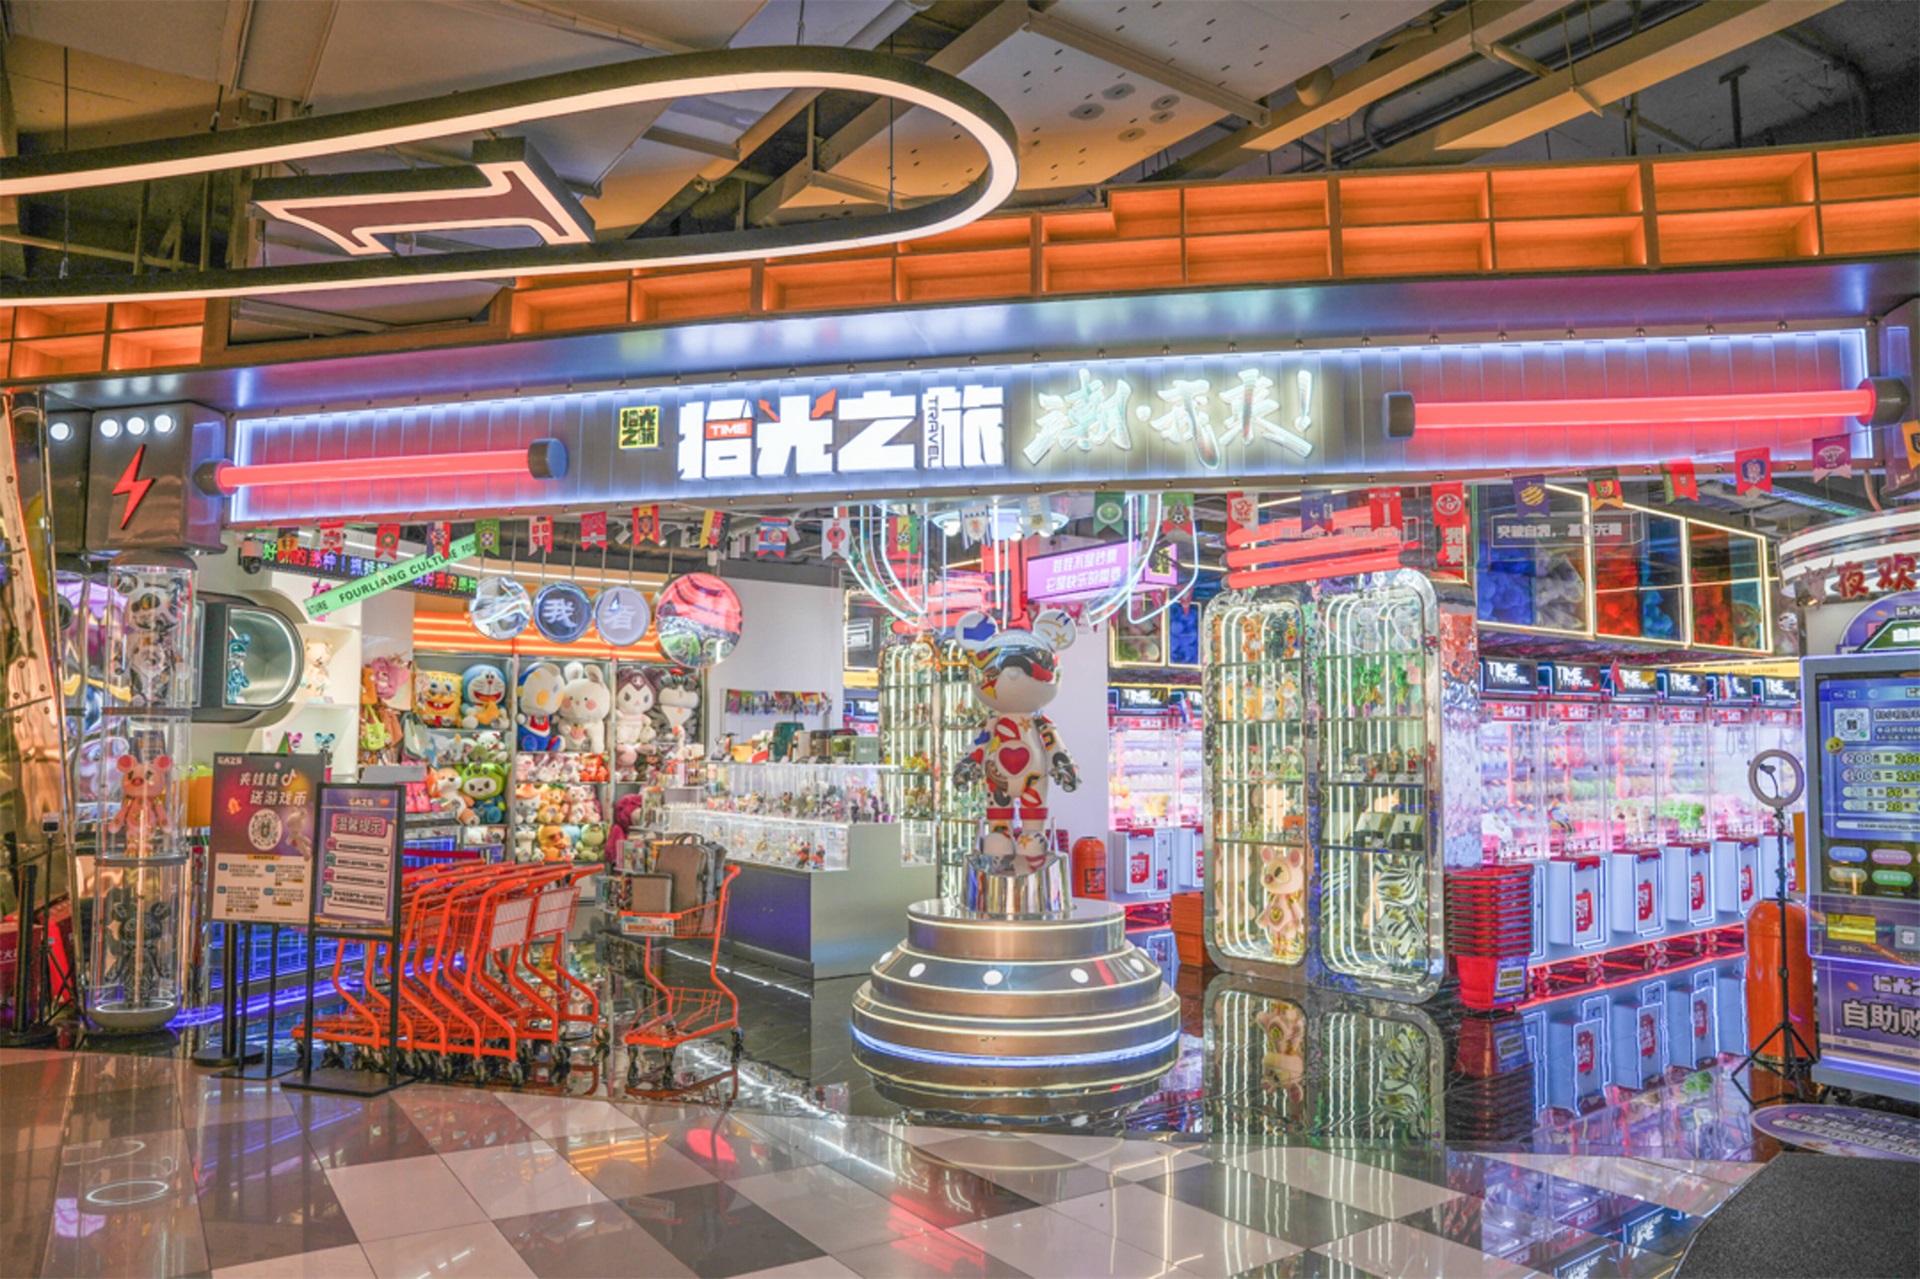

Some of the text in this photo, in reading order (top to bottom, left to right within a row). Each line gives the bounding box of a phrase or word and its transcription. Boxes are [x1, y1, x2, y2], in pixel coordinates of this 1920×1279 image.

[677, 385, 1004, 481] 拾光之旅
[710, 422, 748, 437] TIME
[927, 395, 940, 468] TRAVEL
[338, 569, 407, 603] FOURLIANG
[409, 548, 458, 575] CULTUE
[250, 789, 308, 806] 送游戏币
[336, 816, 382, 835] 温馨提示
